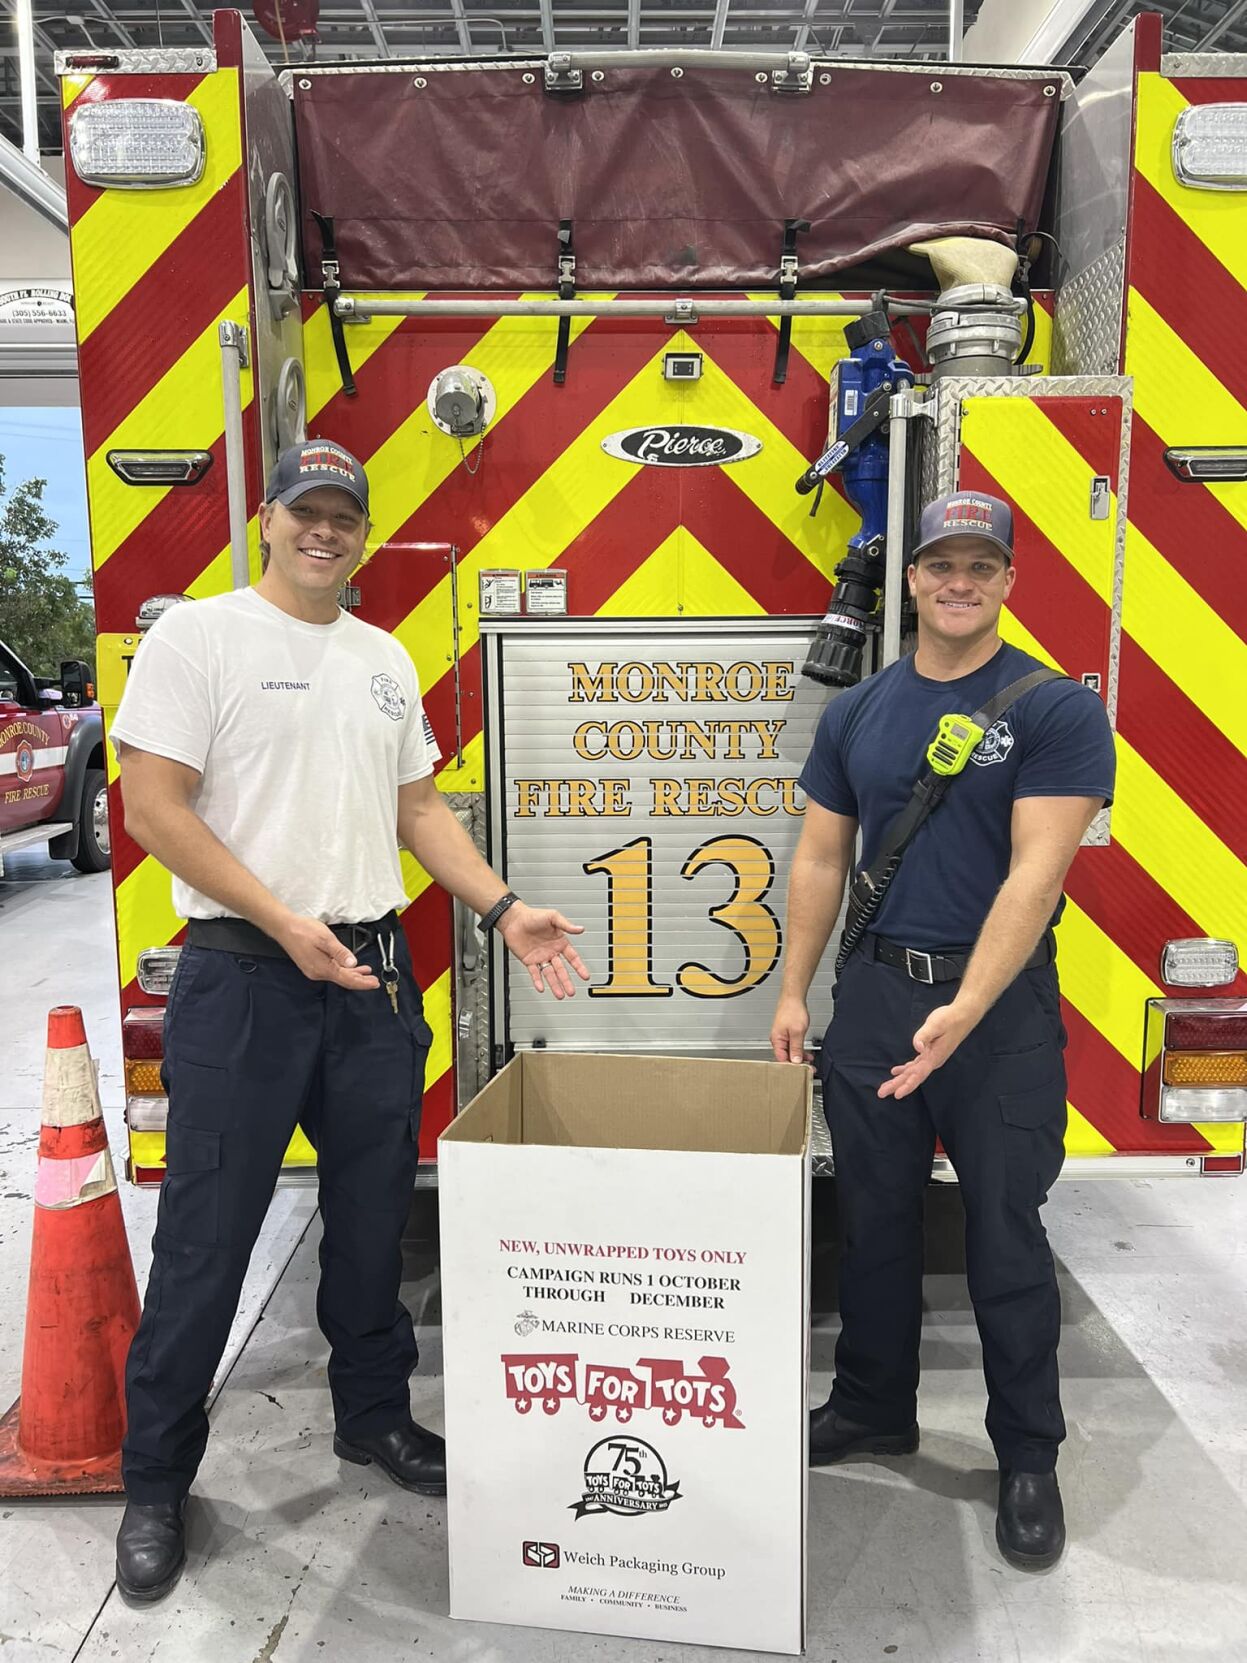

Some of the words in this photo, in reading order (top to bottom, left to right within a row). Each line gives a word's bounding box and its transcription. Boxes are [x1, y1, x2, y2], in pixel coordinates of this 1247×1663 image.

[637, 430, 726, 461] Pierce
[299, 463, 356, 482] RESCUE
[300, 452, 355, 475] FIRE
[943, 519, 993, 531] RESCUE
[261, 681, 311, 691] LIEUTENANT
[567, 661, 795, 703] MONROE
[23, 721, 50, 746] COUNTY
[573, 720, 787, 761] COUNTY
[4, 789, 21, 804] FIRE
[23, 784, 49, 800] RESCUE
[514, 779, 632, 817] FIRE
[649, 778, 808, 817] RESCU
[582, 834, 782, 998] 13
[499, 1239, 540, 1255] NEW,
[544, 1242, 649, 1260] UNWRAPPED
[652, 1247, 697, 1263] TOYS
[701, 1250, 747, 1264] ONLY
[507, 1266, 595, 1283] CAMPAIGN
[599, 1272, 642, 1286] RUNS
[647, 1274, 654, 1286] 1
[659, 1275, 741, 1291] OCTOBER
[523, 1286, 605, 1303] THROUGH
[630, 1292, 725, 1309] DECEMBER
[542, 1320, 604, 1336] MARINE
[608, 1324, 659, 1339] CORPS
[664, 1328, 735, 1343] RESERVE
[508, 1361, 573, 1393] TOYS
[588, 1371, 639, 1404] FOR
[655, 1378, 725, 1412] TOTS
[607, 1442, 647, 1476] 75th
[586, 1474, 608, 1487] TOYS
[613, 1478, 631, 1490] FOR
[636, 1481, 660, 1493] TOTS
[593, 1494, 658, 1510] ANNIVERSARY
[609, 1555, 679, 1575] Packaging
[682, 1562, 726, 1579] Group
[568, 1585, 607, 1597] MAKING
[609, 1590, 616, 1598] A
[617, 1591, 680, 1604] DIFFERENCE
[599, 1599, 643, 1608] COMMUNITY
[654, 1604, 688, 1612] BUSINESS
